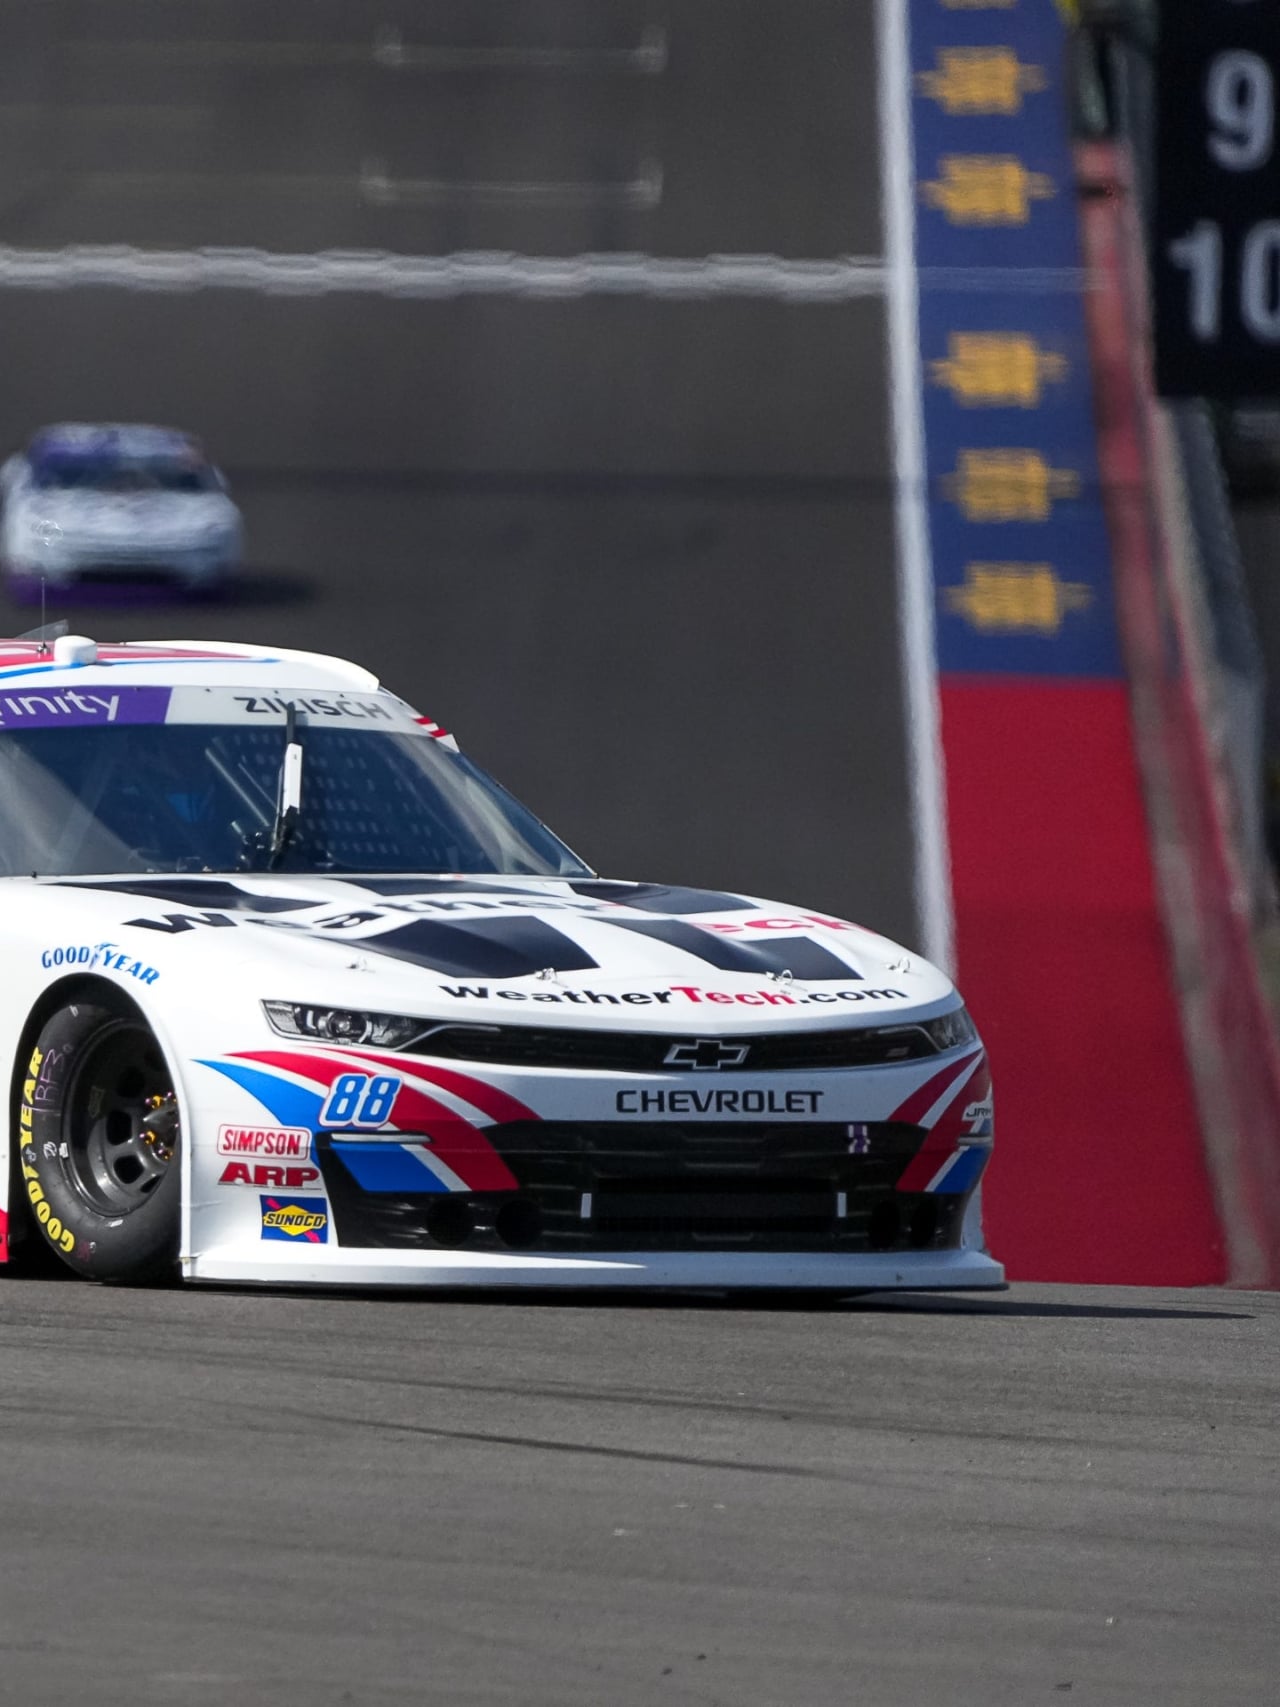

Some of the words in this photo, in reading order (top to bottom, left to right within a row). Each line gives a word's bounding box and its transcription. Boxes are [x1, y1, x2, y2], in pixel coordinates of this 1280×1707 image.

[1206, 48, 1275, 172] 9
[1169, 218, 1280, 343] 10
[439, 985, 908, 1007] WeatherTech.com
[320, 1073, 404, 1128] 88
[616, 1090, 824, 1113] CHEVROLET
[223, 1129, 301, 1156] SIMPSON
[219, 1161, 320, 1187] ARP
[265, 1213, 326, 1228] SUNOCO
